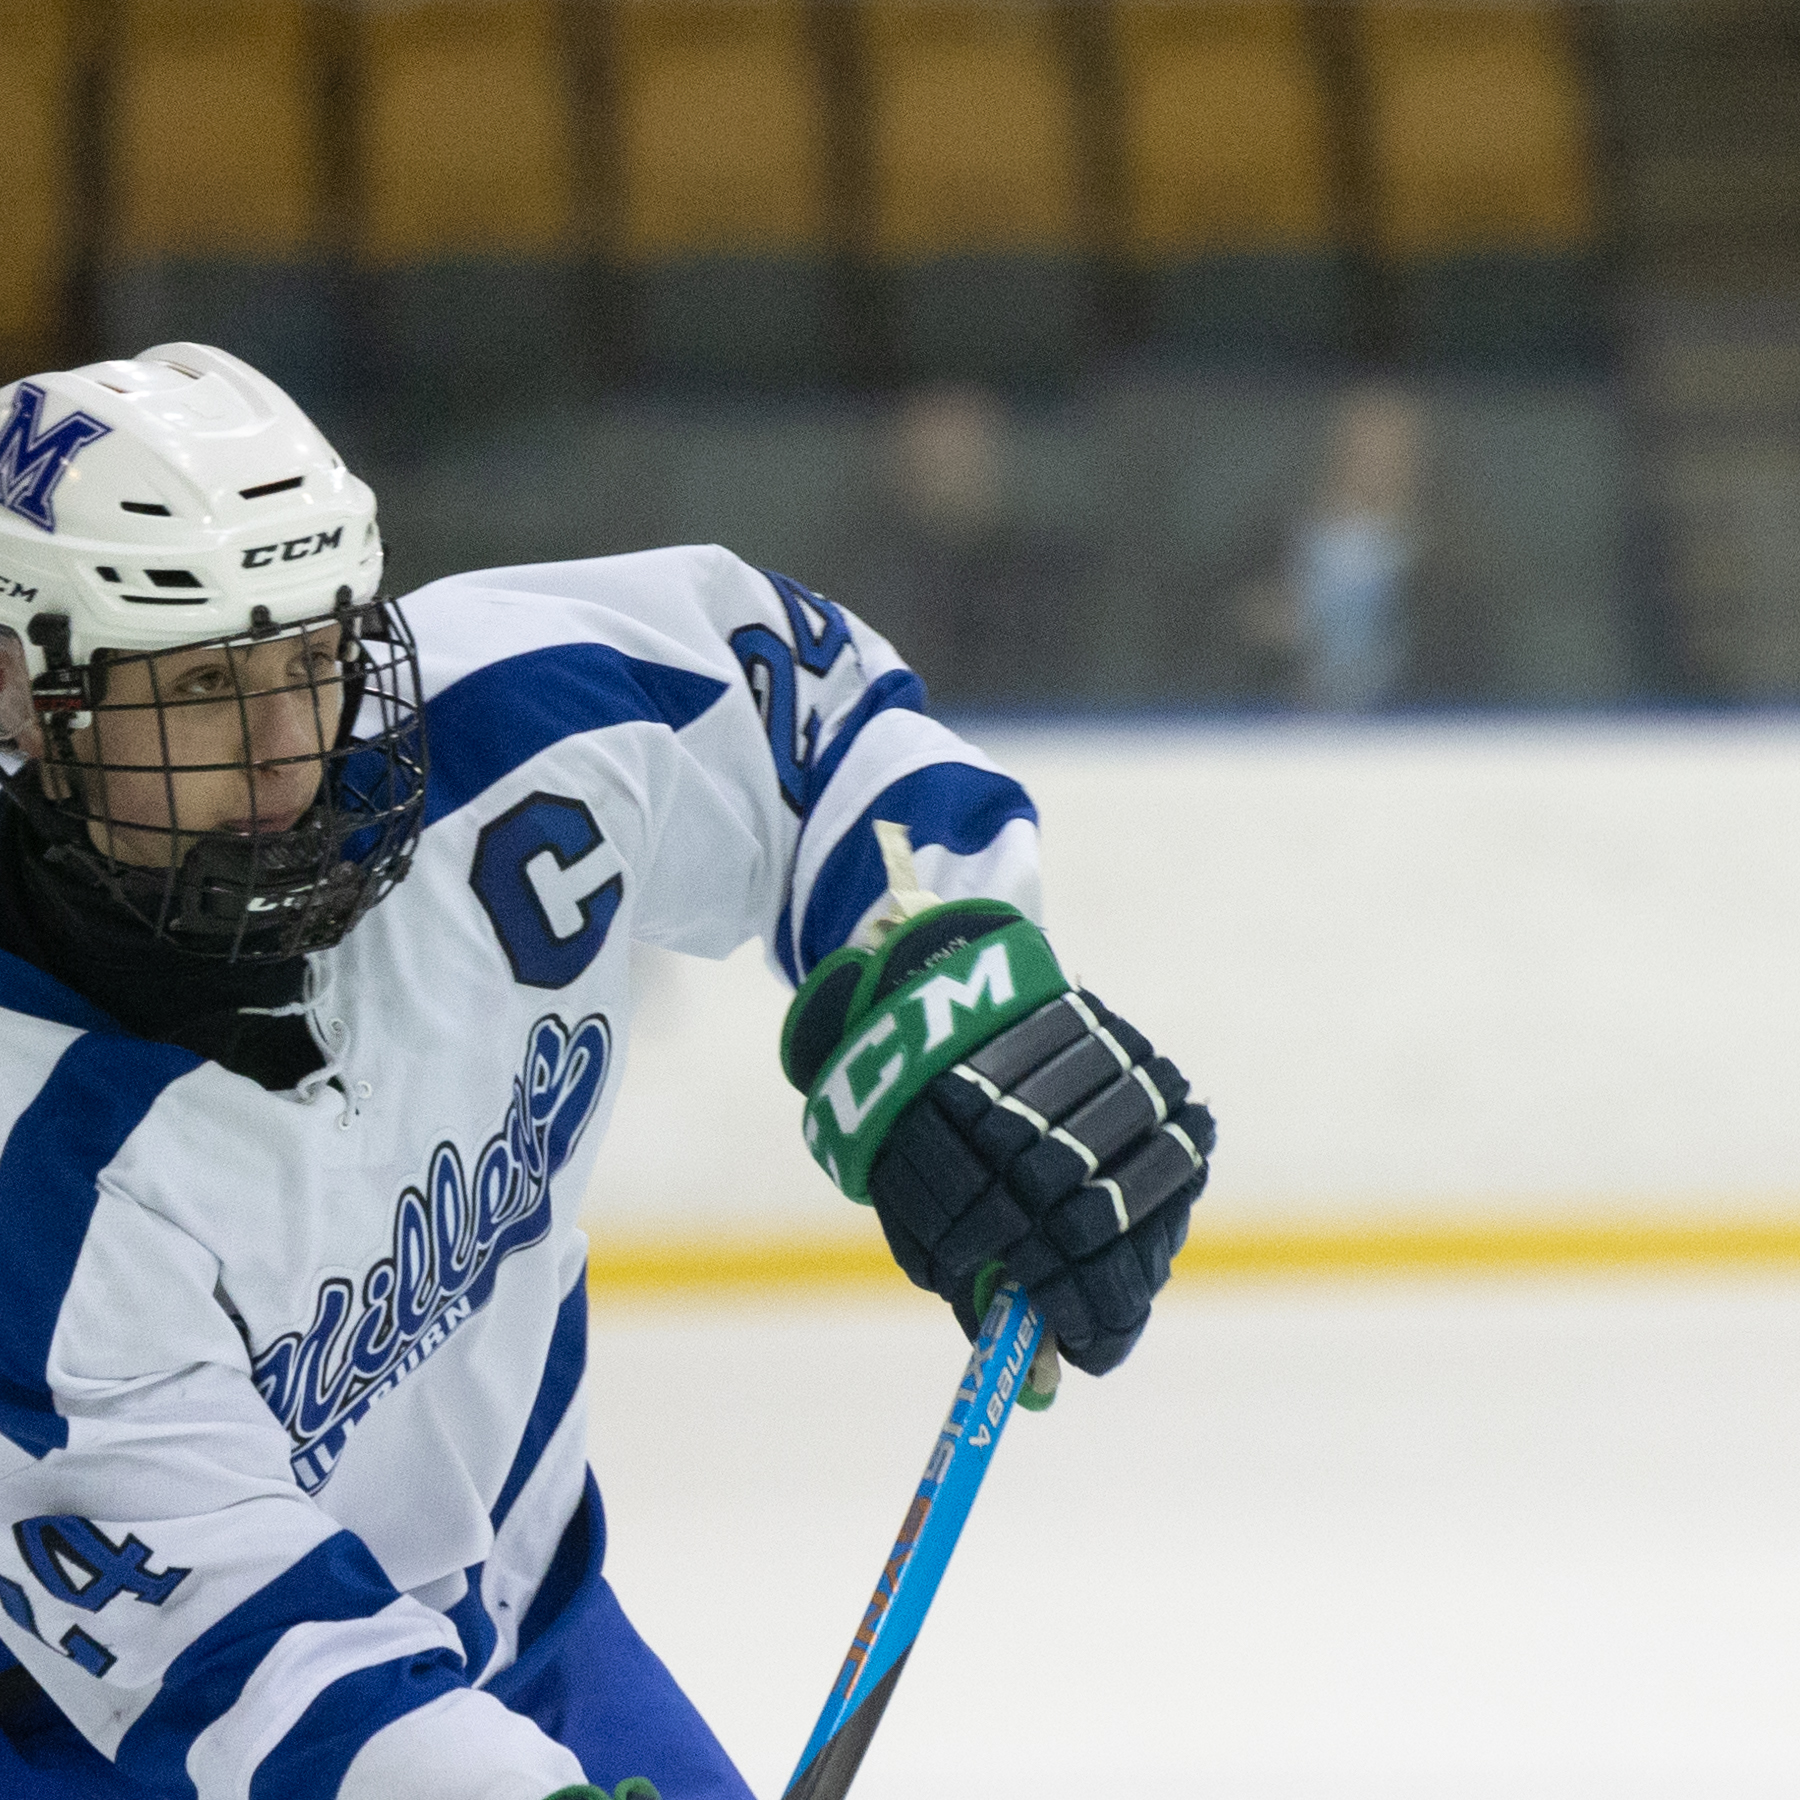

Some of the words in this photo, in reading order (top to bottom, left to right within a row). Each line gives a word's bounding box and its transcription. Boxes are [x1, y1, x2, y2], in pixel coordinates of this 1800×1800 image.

[242, 526, 344, 569] CCM
[468, 790, 624, 990] C
[923, 1280, 1024, 1484] EXUS
